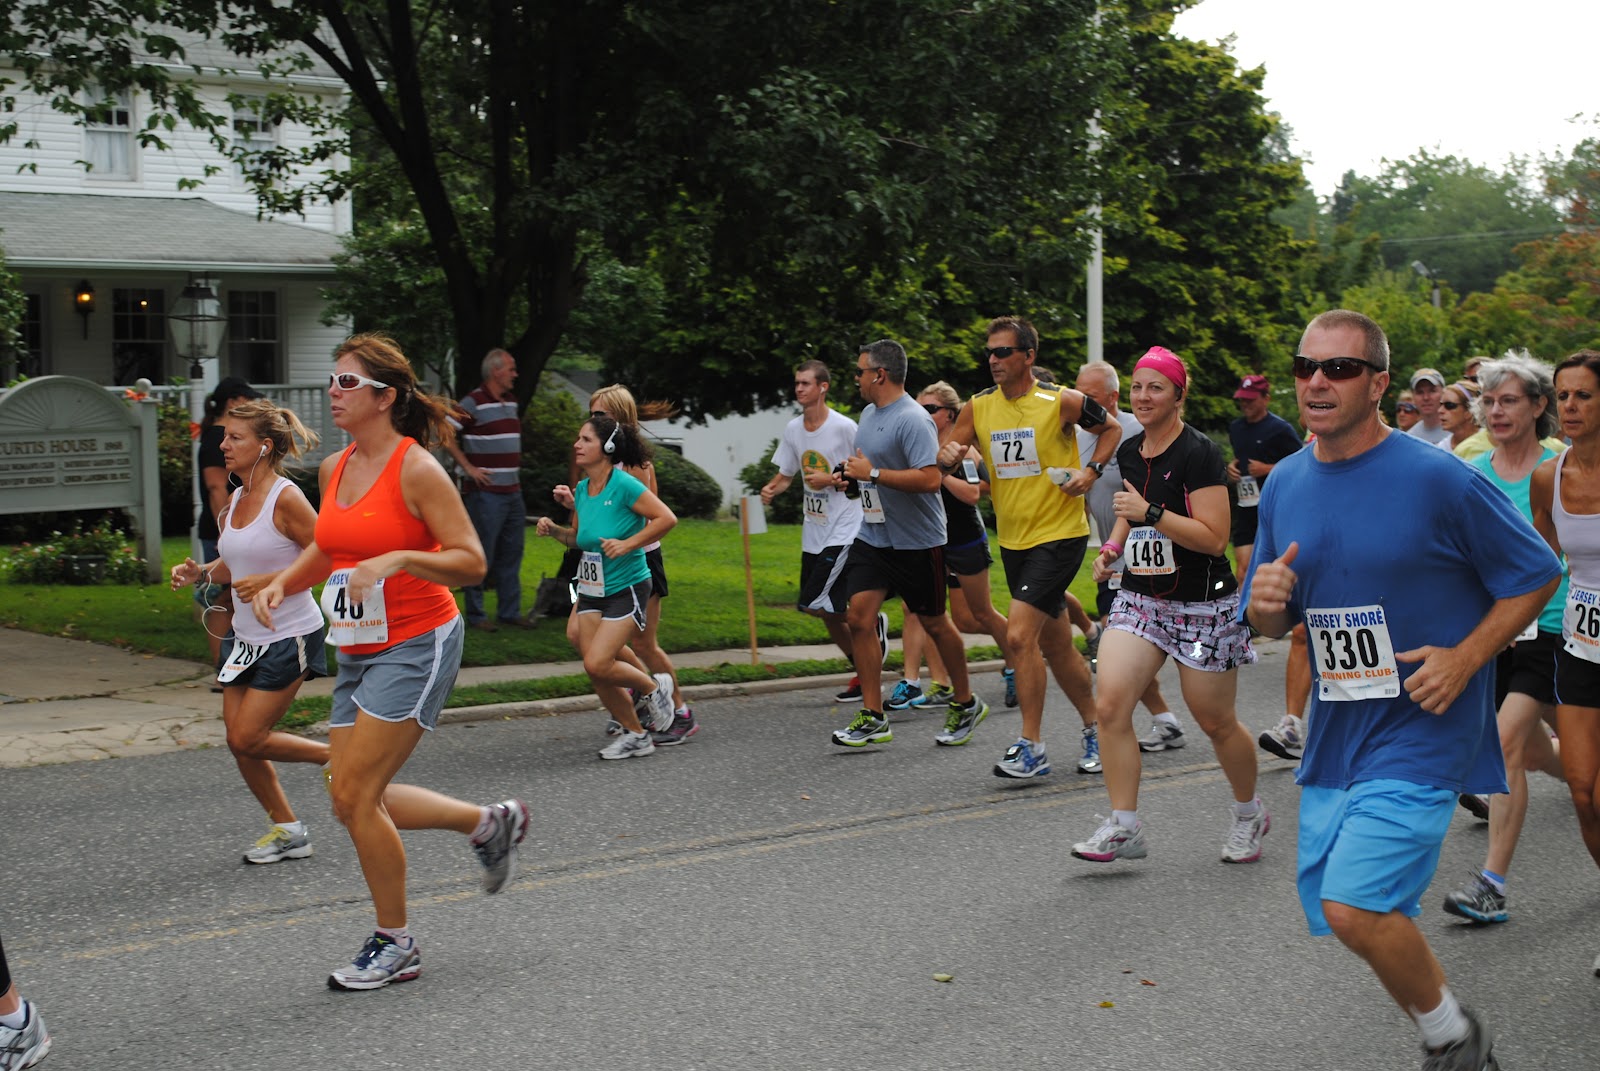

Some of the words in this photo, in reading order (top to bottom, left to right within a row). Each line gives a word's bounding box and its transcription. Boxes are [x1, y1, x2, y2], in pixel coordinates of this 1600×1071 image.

[990, 432, 1011, 442] JERSEY
[1014, 430, 1034, 440] SHORE
[51, 439, 97, 453] HOUSE
[1002, 440, 1025, 462] 72
[806, 496, 823, 513] 112
[1129, 530, 1147, 540] JERSEY
[1149, 530, 1169, 540] SHO
[1132, 541, 1165, 567] 148
[580, 562, 598, 582] 188
[1571, 589, 1598, 606] JERSEY
[332, 621, 356, 629] NNING
[360, 619, 382, 627] CLUB
[1309, 613, 1341, 629] JERSEY
[1345, 610, 1385, 628] SHORE
[1320, 628, 1380, 671] 330
[1321, 671, 1362, 680] RUNNING
[1365, 668, 1392, 678] CLUB
